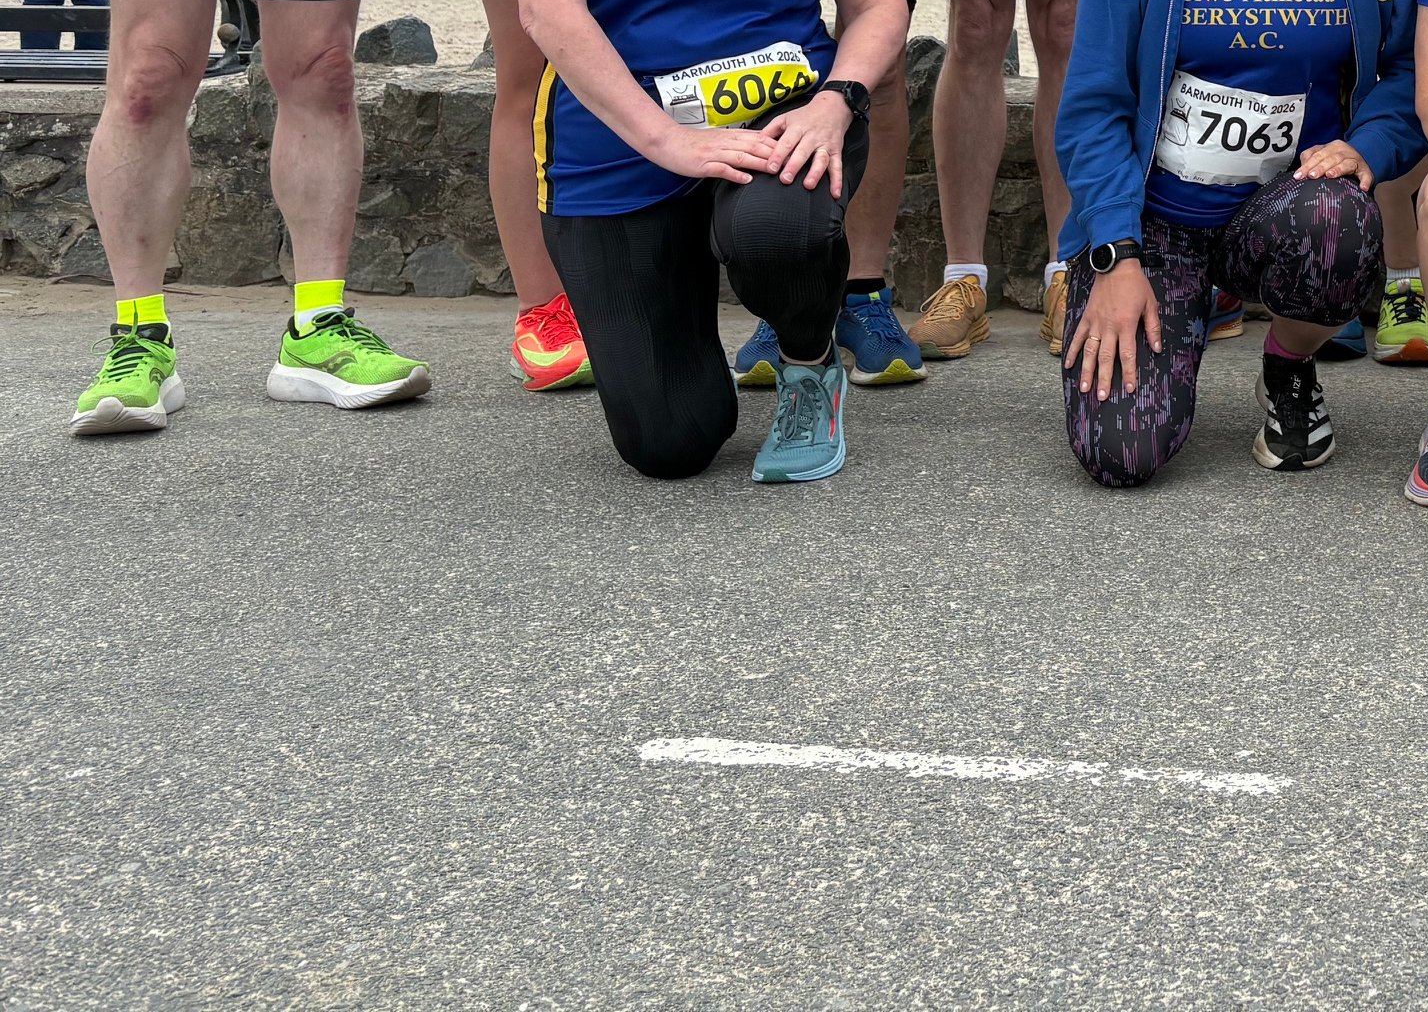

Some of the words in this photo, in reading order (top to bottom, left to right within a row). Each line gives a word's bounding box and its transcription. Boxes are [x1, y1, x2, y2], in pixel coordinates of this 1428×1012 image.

[1229, 32, 1284, 49] A.C.
[751, 53, 774, 65] 10K
[777, 51, 800, 62] 2026
[1180, 83, 1243, 108] BARMOUTH
[1248, 100, 1267, 114] 10K
[1270, 103, 1296, 115] 2026
[1197, 110, 1294, 154] 7063
